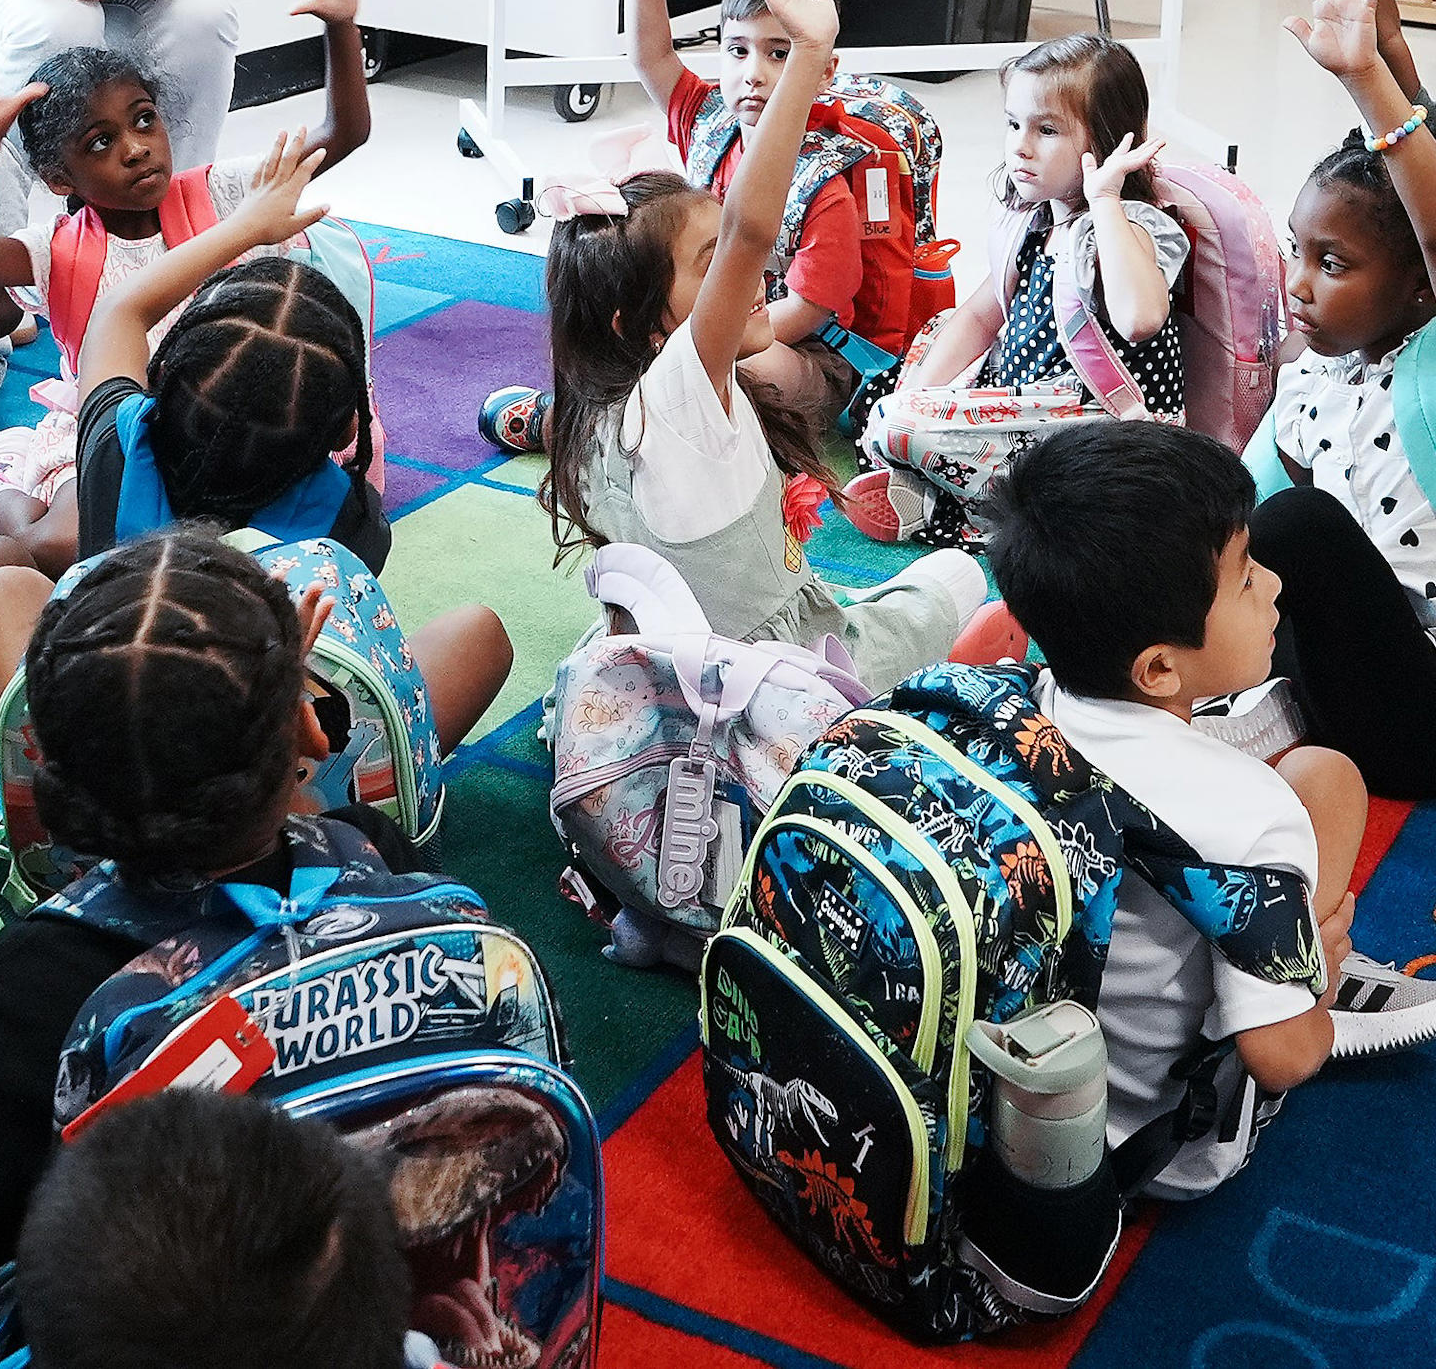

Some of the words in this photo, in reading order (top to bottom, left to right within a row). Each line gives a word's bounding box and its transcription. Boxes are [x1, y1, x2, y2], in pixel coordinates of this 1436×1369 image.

[862, 222, 890, 236] Blue
[717, 964, 760, 1034] DINO
[275, 1002, 416, 1071] WORLD
